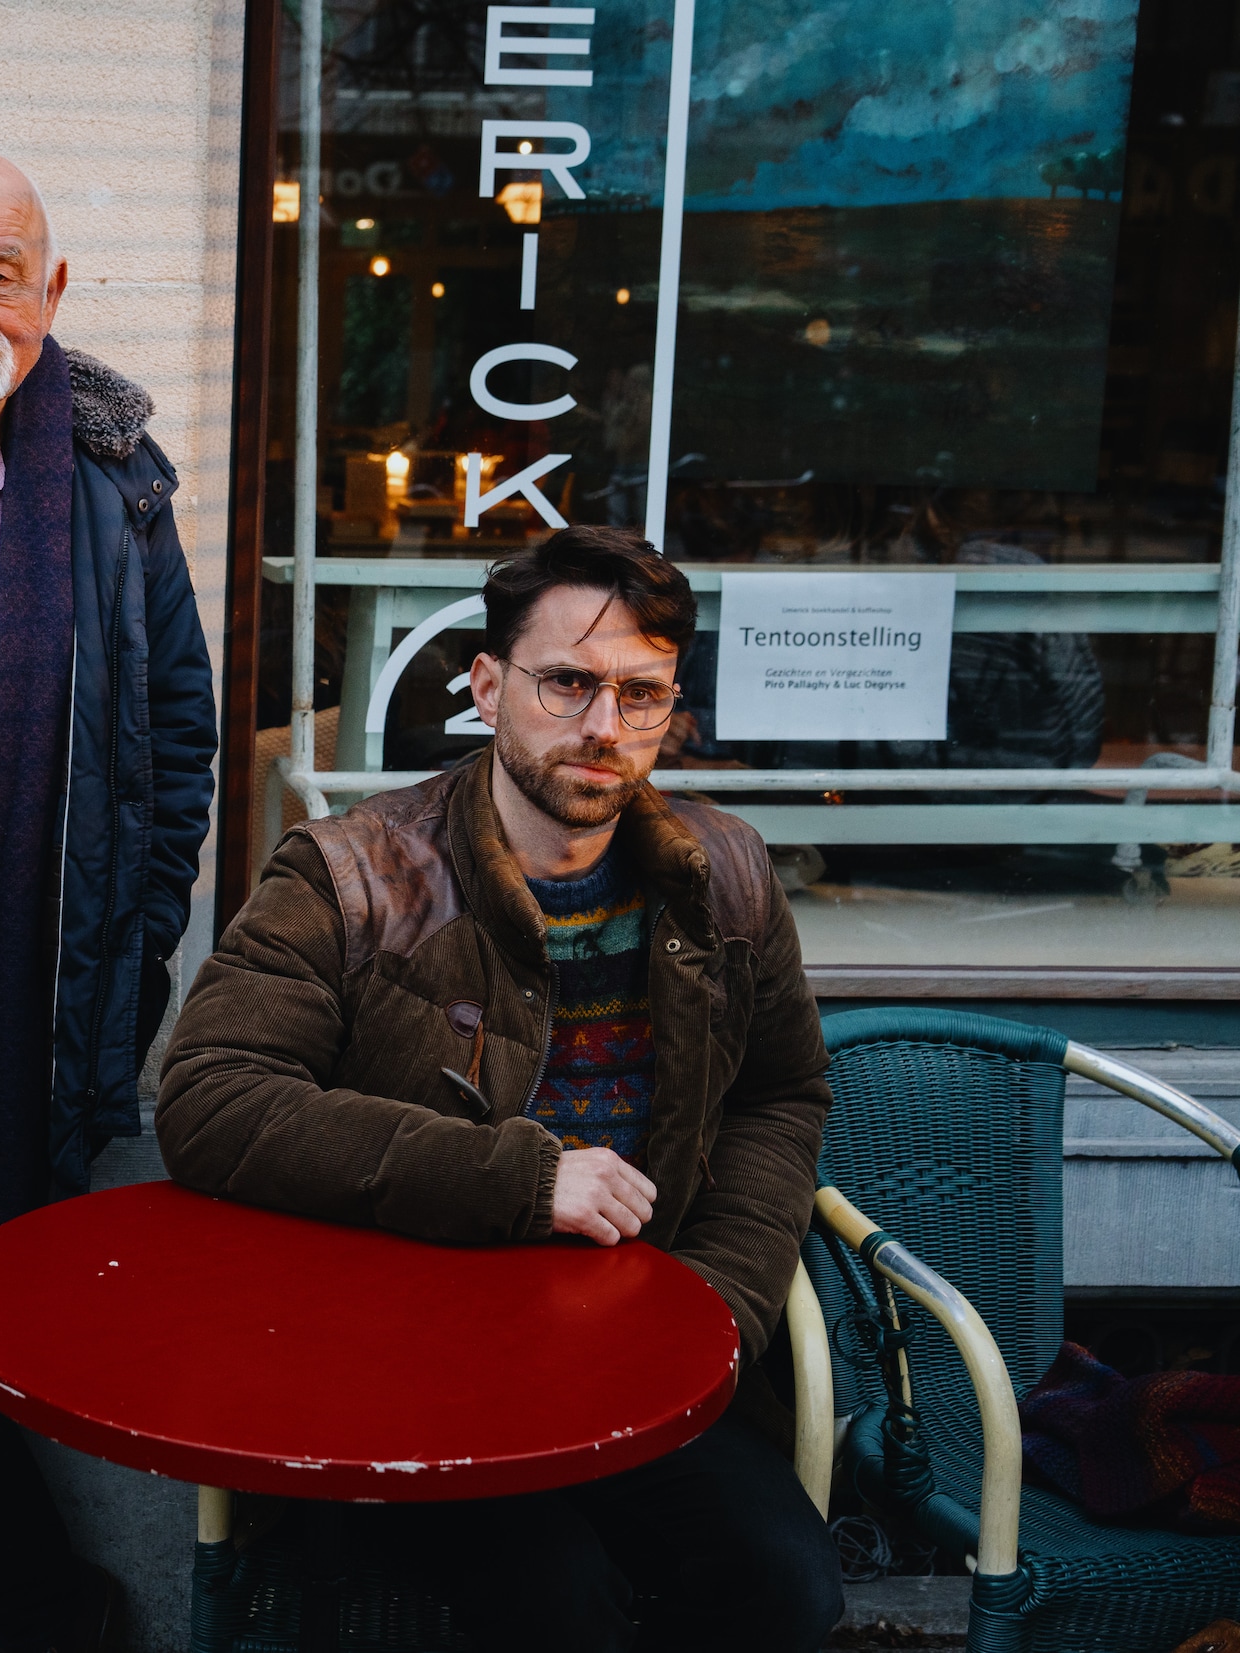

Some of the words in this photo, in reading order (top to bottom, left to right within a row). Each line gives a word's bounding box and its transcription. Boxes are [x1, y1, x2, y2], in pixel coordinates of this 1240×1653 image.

[739, 626, 922, 651] Tentoonstelling
[765, 668, 811, 677] Gezichten
[788, 680, 830, 691] Pallaghy
[834, 681, 841, 689] &
[844, 680, 861, 689] Luc
[864, 680, 906, 691] Degryse
